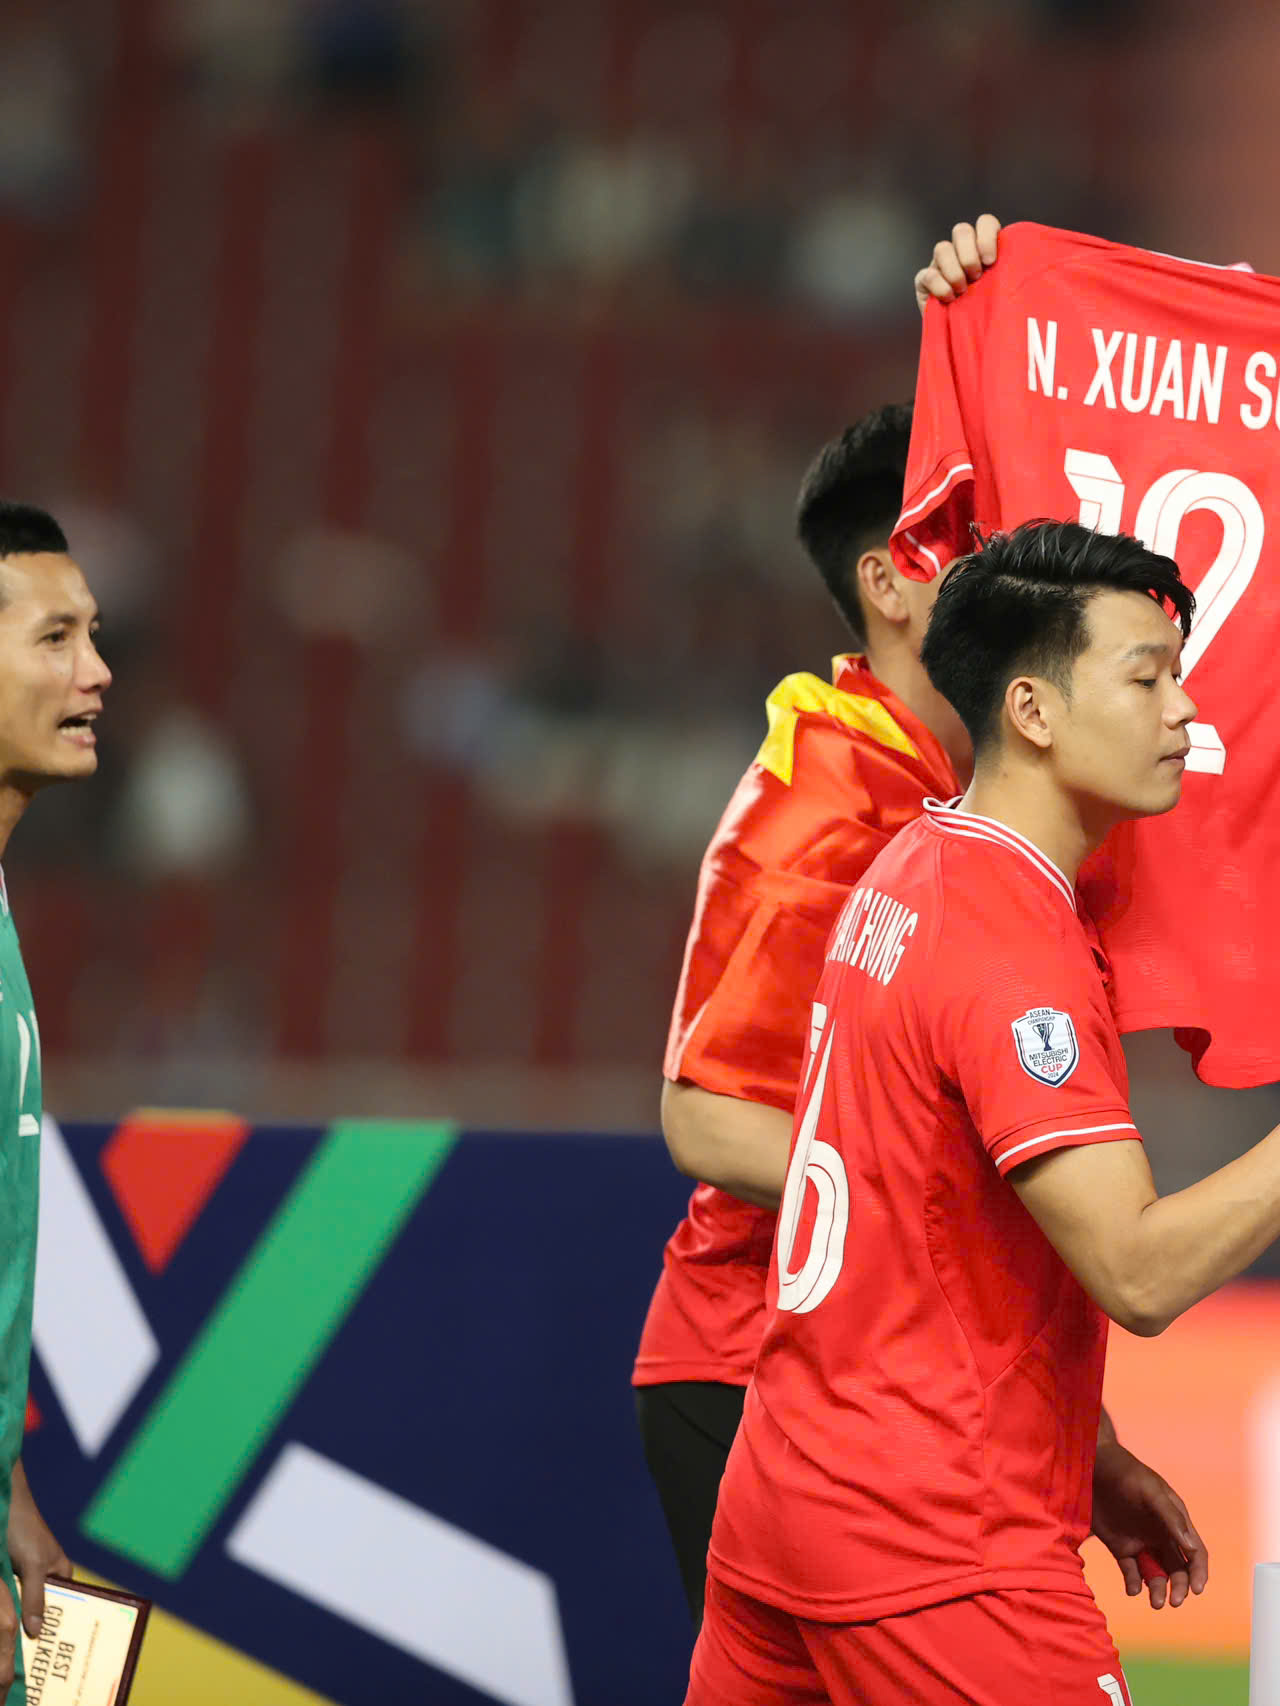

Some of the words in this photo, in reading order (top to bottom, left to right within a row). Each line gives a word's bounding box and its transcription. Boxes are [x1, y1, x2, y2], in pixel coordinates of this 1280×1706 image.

[1025, 317, 1067, 401] N.
[1083, 327, 1228, 425] XUAN
[1029, 1009, 1051, 1019] ASEAN
[1029, 1047, 1069, 1061] MITSUBISHI
[1033, 1055, 1067, 1067] ELECTRIC
[1041, 1063, 1063, 1074] CUP
[52, 1641, 76, 1682] BEST
